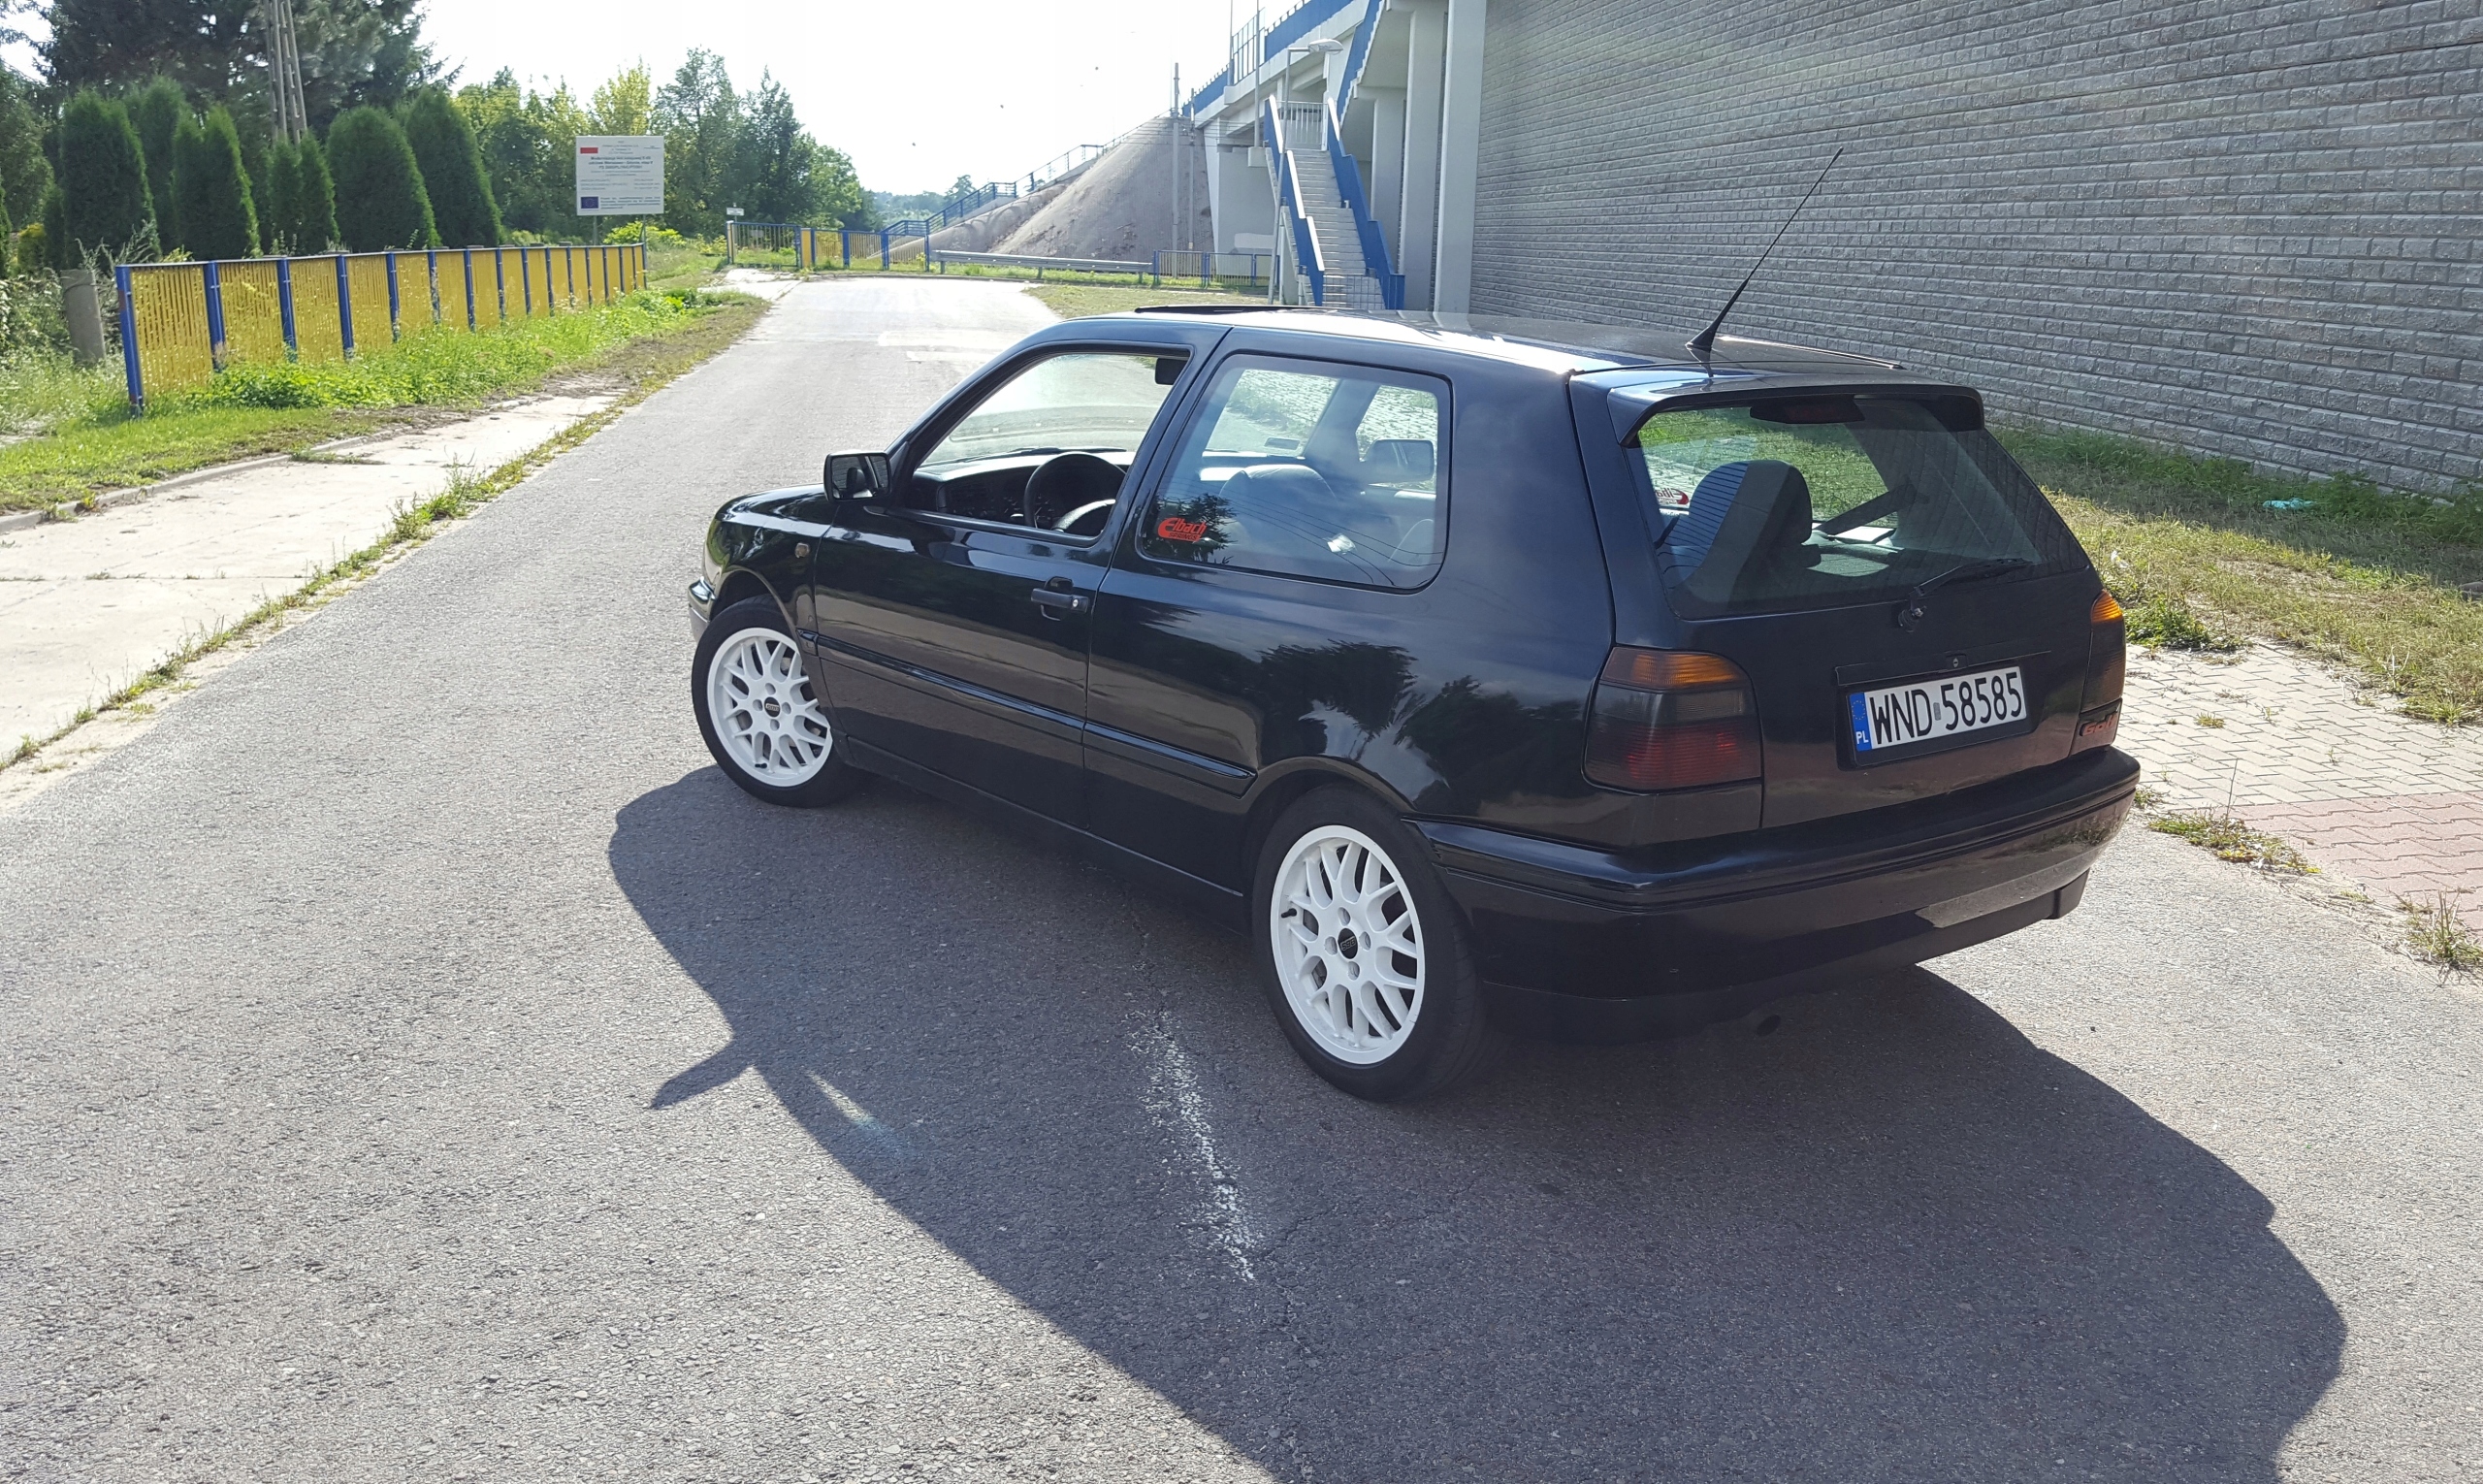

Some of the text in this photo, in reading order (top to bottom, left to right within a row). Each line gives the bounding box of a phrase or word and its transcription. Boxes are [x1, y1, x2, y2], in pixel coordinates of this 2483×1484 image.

[1169, 532, 1199, 540] SPRINGS
[1869, 671, 2022, 745] WND 58585
[1855, 730, 1869, 745] PL
